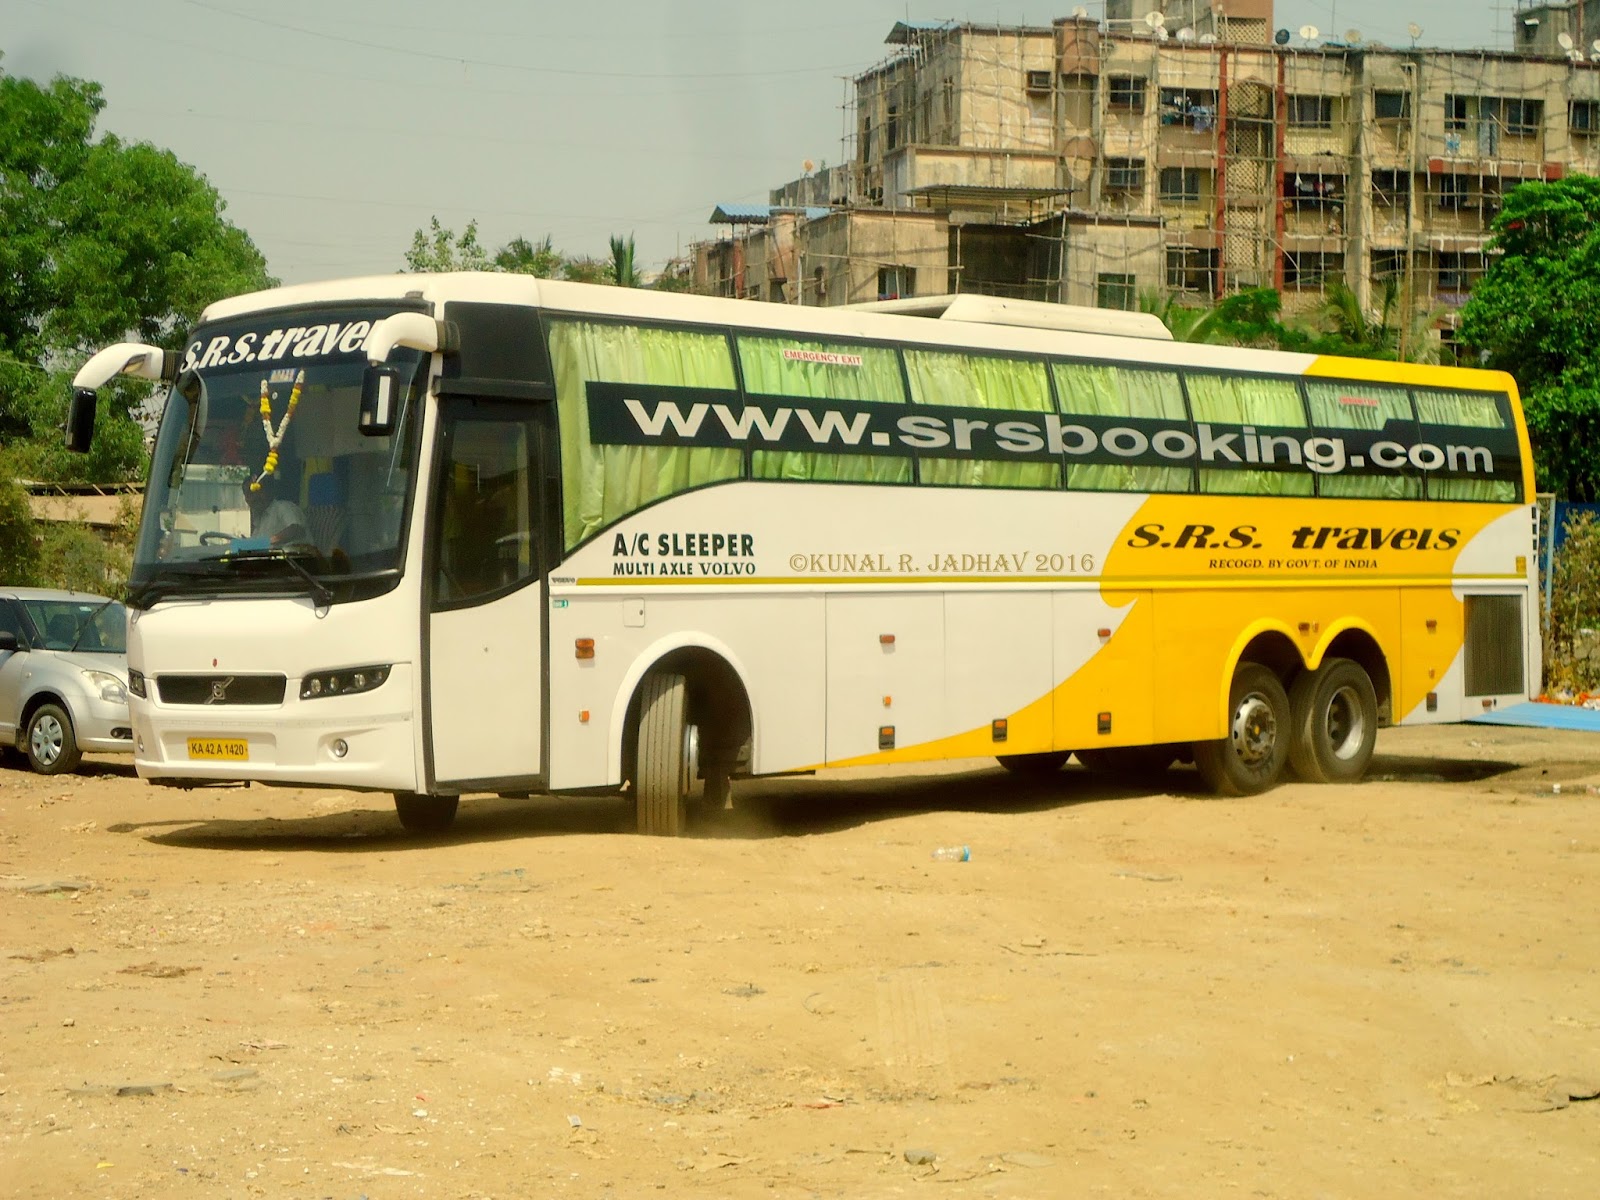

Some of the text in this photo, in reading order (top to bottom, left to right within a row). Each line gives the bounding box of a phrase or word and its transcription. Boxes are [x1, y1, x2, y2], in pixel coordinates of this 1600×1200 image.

[784, 350, 861, 364] EMERGENCY EXIT
[624, 399, 1494, 473] www.srsbooking.com
[1127, 523, 1461, 551] S.R.S. travels
[613, 533, 754, 557] A/C SLEEPER
[613, 562, 756, 575] MULTI AXLE VOLVO
[1209, 559, 1378, 569] RECOGD. BY GOVT. OF INDIA
[191, 743, 244, 755] KA 42 A 1420
